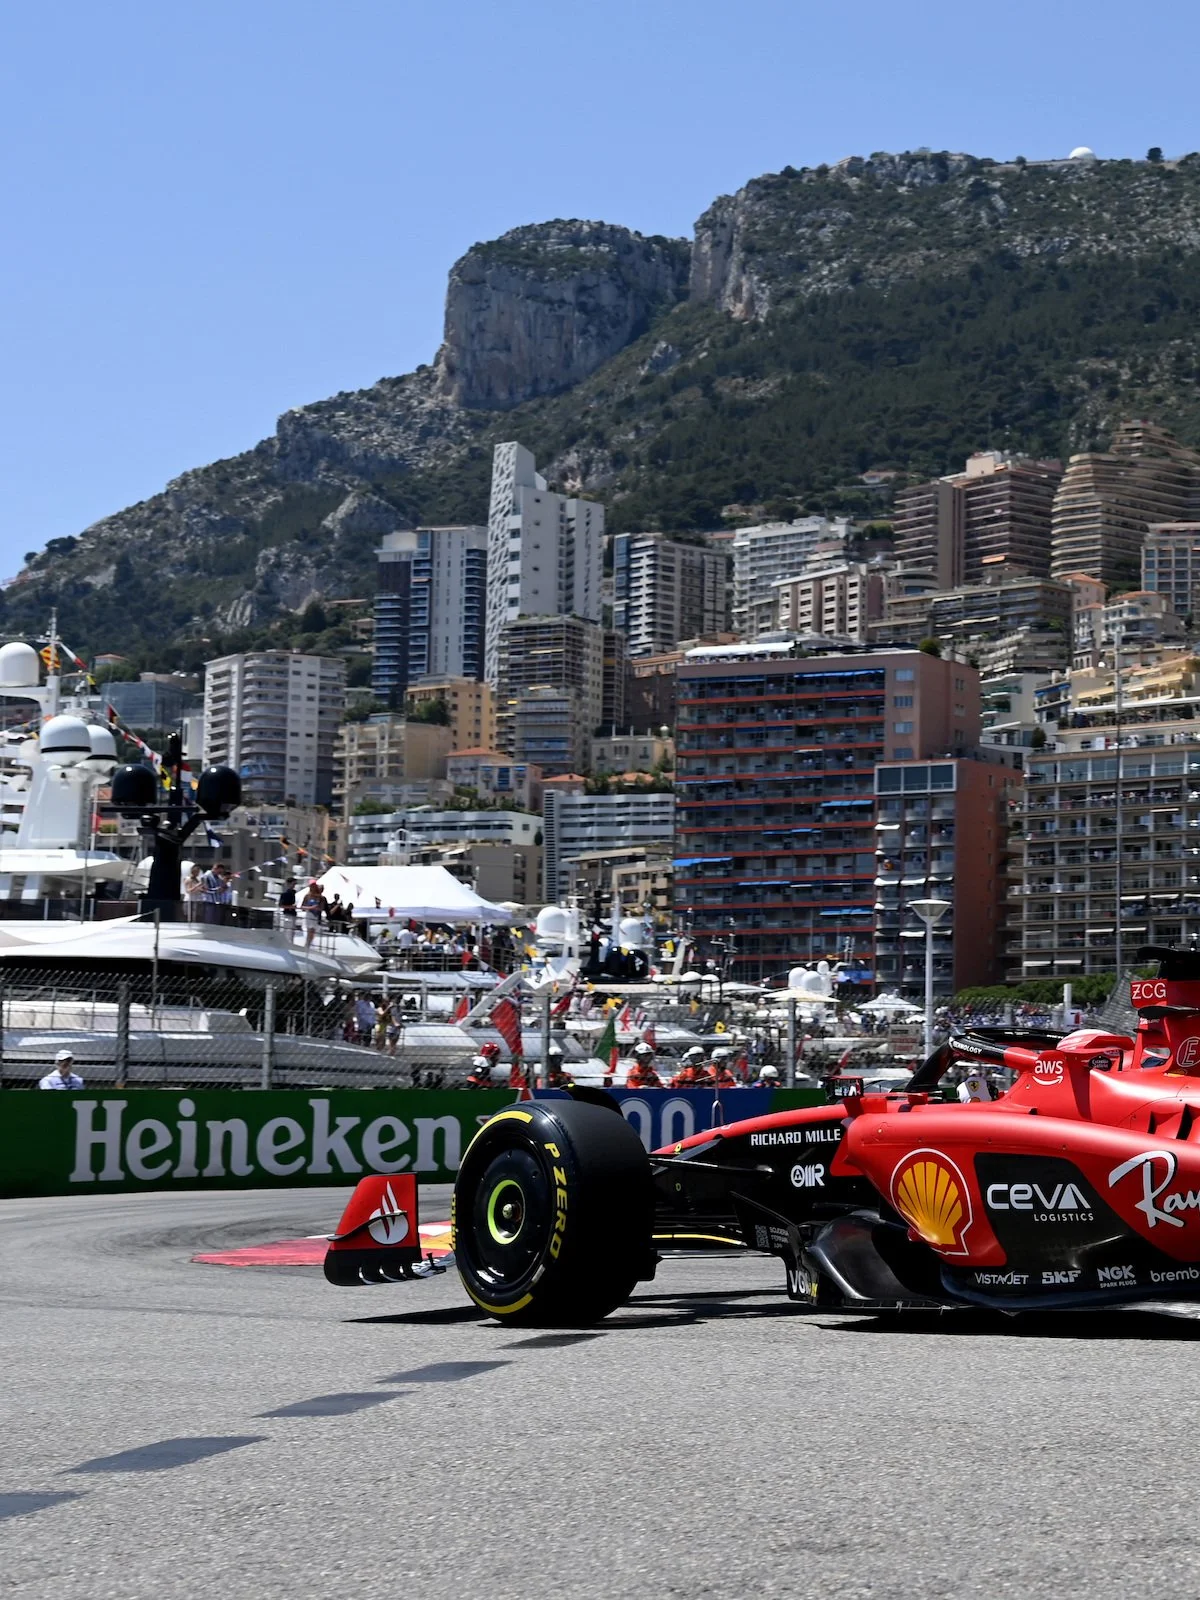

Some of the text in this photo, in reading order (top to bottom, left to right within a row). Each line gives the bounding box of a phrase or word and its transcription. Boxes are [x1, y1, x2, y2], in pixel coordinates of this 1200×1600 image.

[1034, 1060, 1063, 1074] aws
[69, 1098, 463, 1182] Heineken
[751, 1128, 841, 1146] RICHARD MILLE
[544, 1142, 568, 1260] P ZERO
[1033, 1212, 1095, 1222] LOGISTICS
[1041, 1270, 1082, 1285] SKF
[1096, 1264, 1136, 1282] NGK
